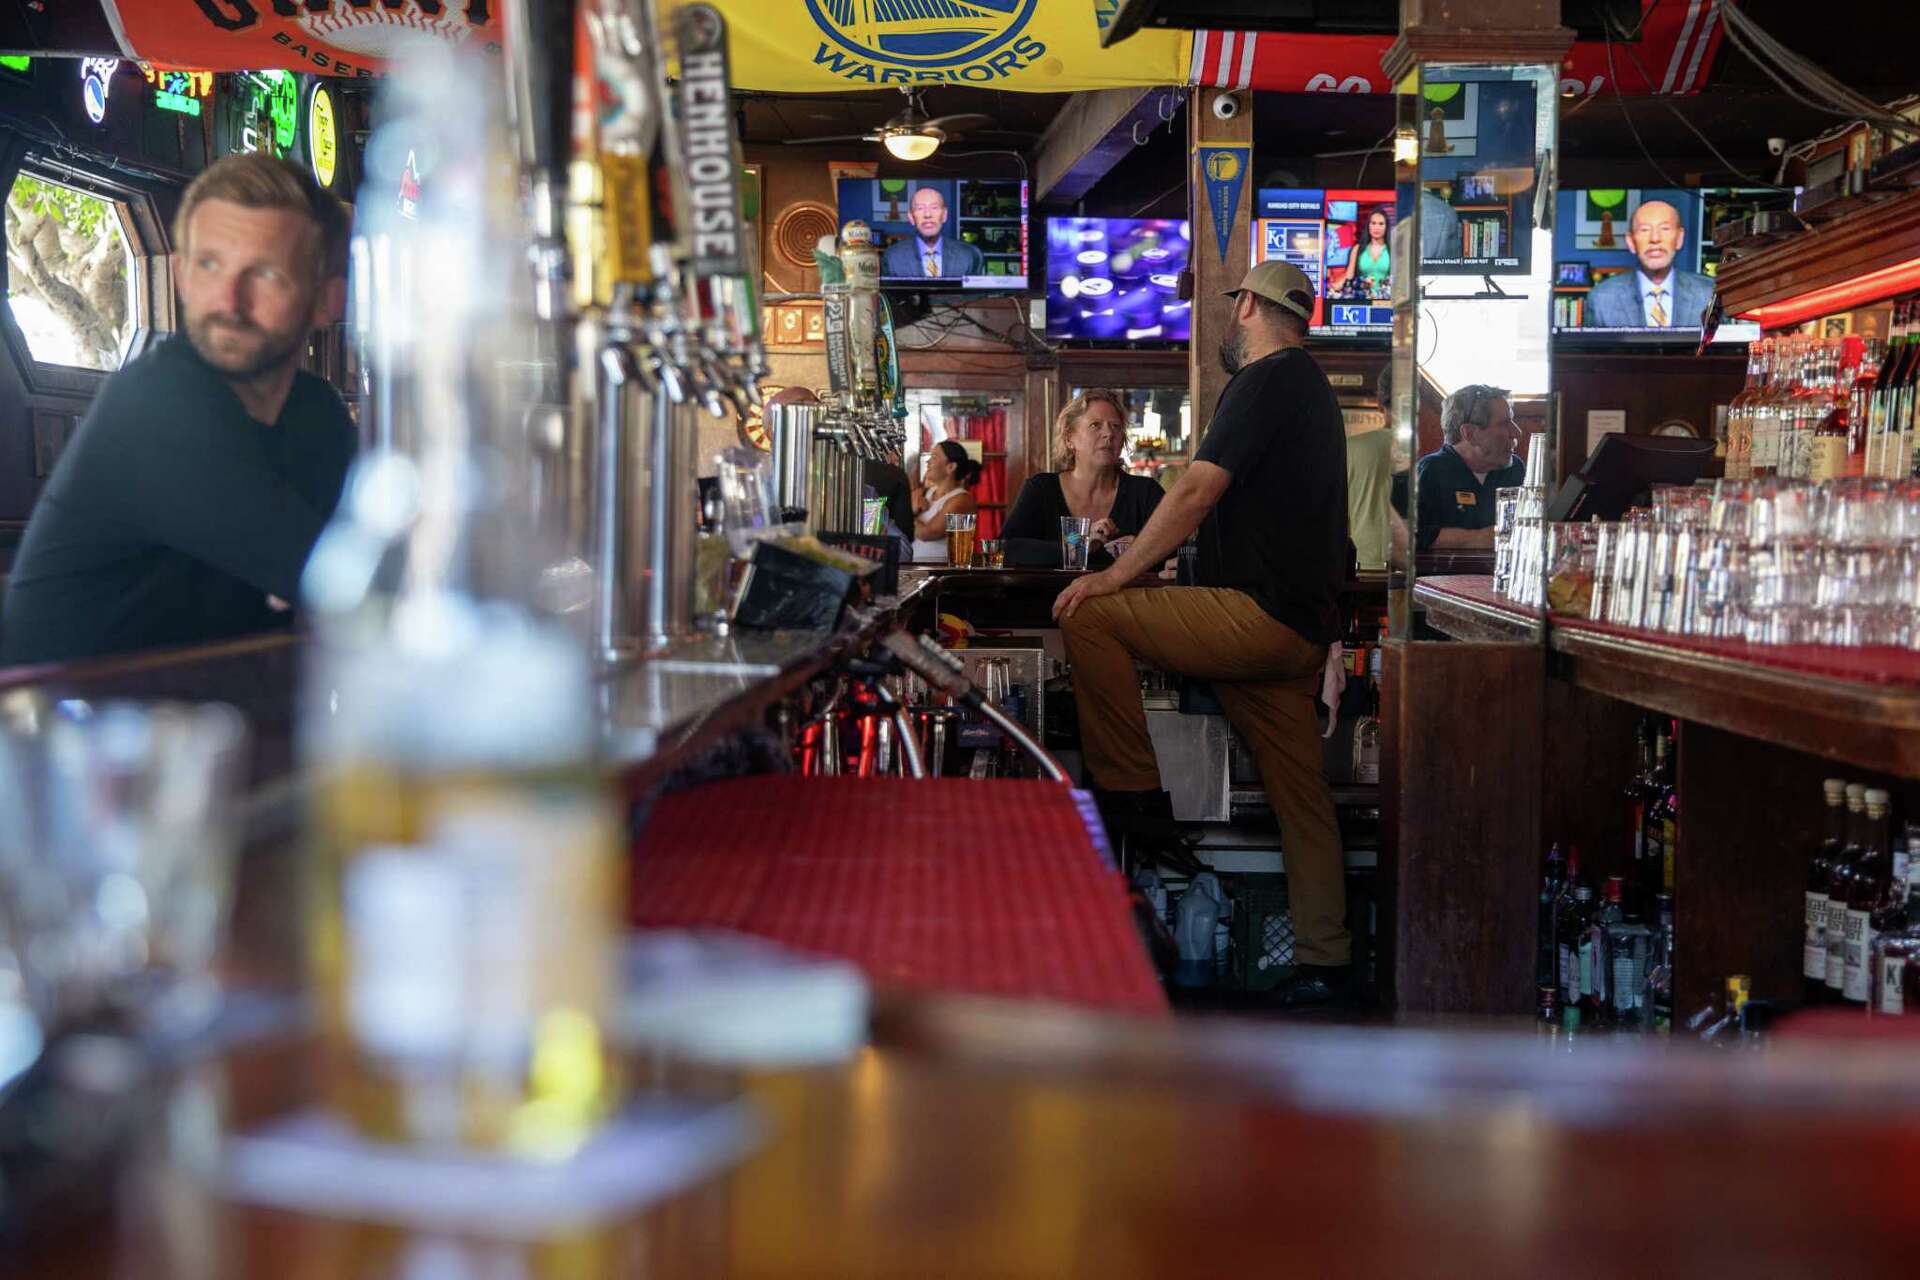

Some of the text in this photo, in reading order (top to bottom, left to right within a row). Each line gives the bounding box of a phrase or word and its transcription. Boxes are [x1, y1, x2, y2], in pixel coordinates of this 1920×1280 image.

[812, 35, 1047, 84] WARRIORS
[684, 52, 737, 257] HENHOUSE
[1268, 229, 1285, 248] KC
[1342, 306, 1360, 324] KC
[836, 333, 848, 387] AMENDMENT
